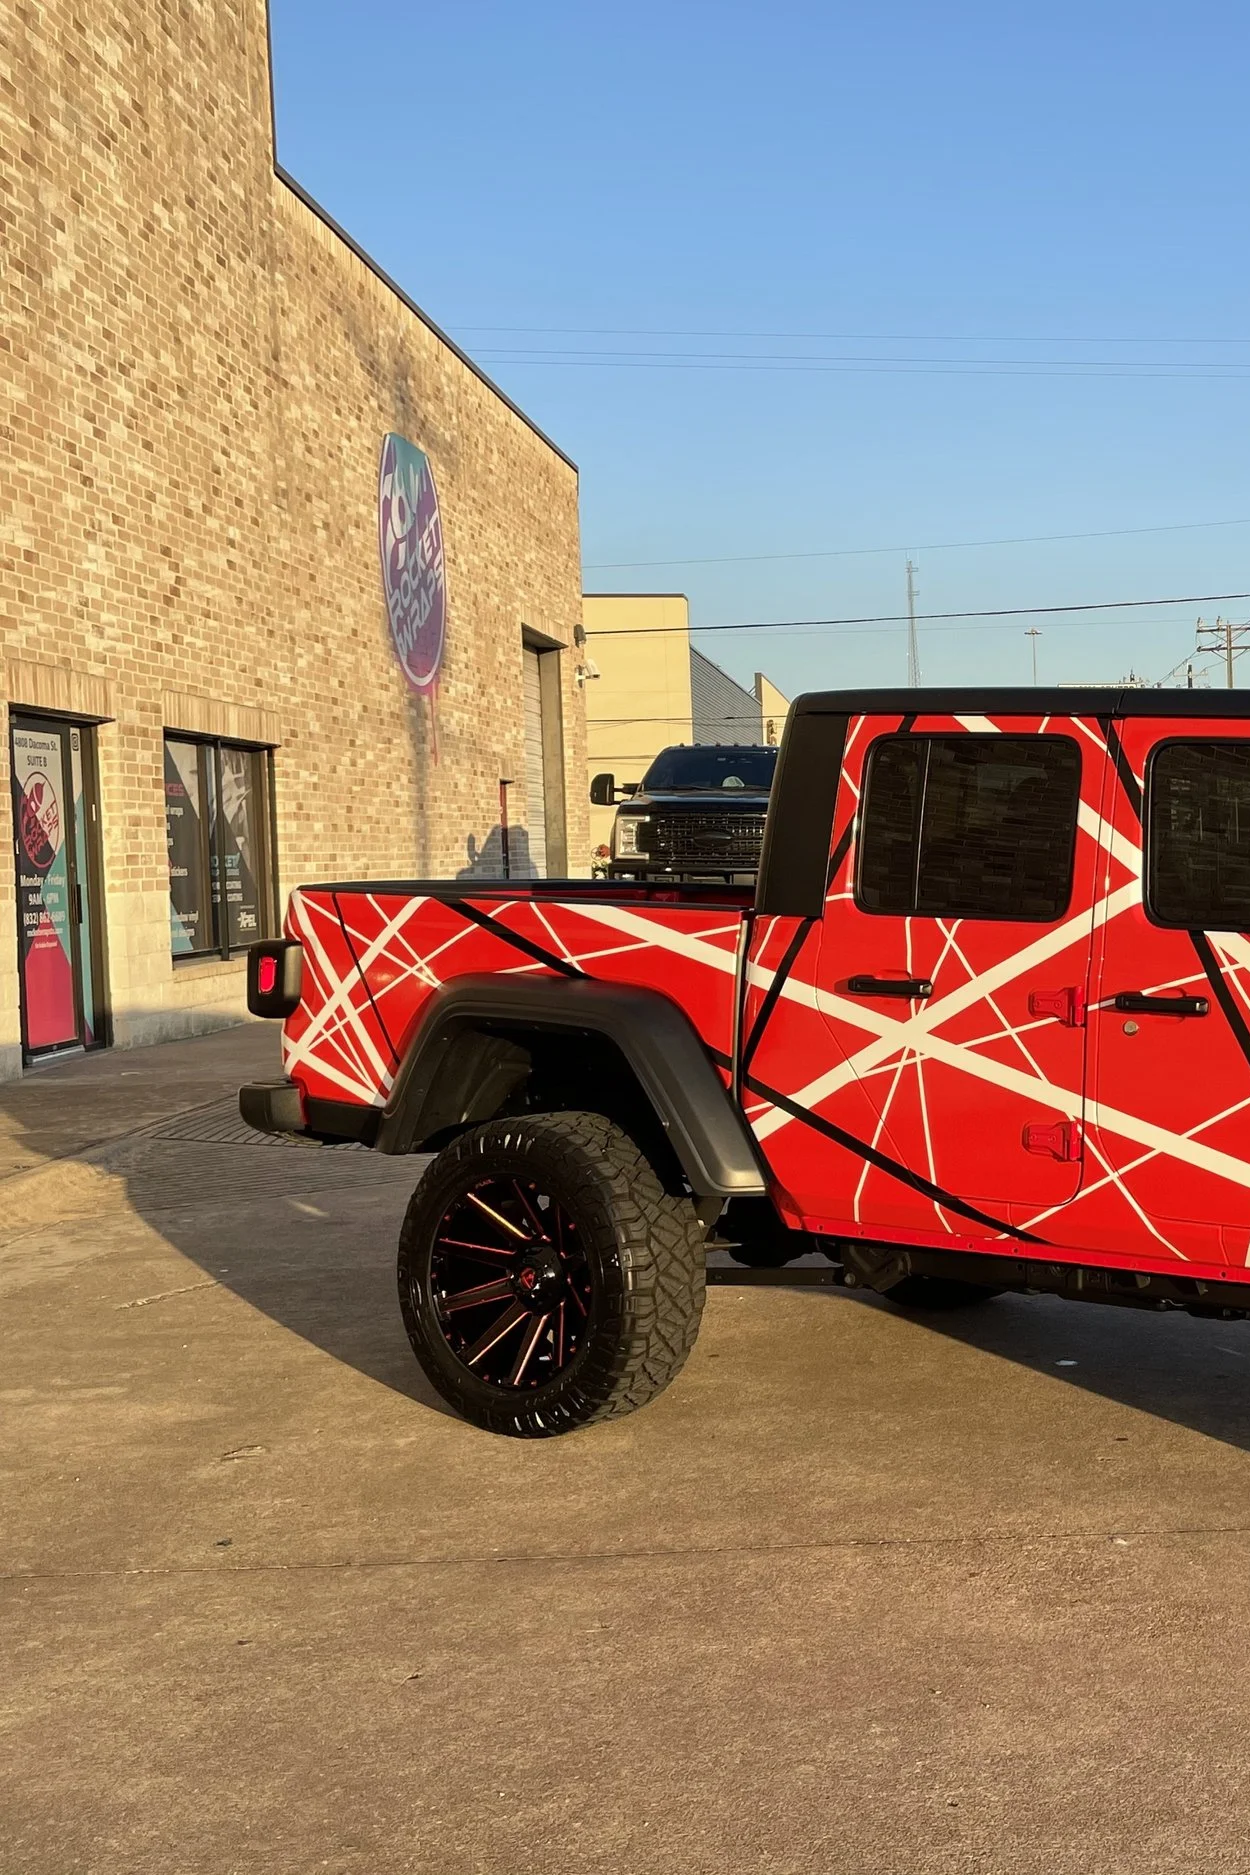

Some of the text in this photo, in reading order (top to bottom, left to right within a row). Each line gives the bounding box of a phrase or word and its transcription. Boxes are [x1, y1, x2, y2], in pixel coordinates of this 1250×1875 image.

[388, 509, 439, 632] ROCKET
[398, 548, 444, 658] WRAPS
[27, 755, 42, 767] SUITE
[20, 873, 43, 889] Monday
[47, 873, 65, 888] Friday
[23, 912, 39, 927] (832)
